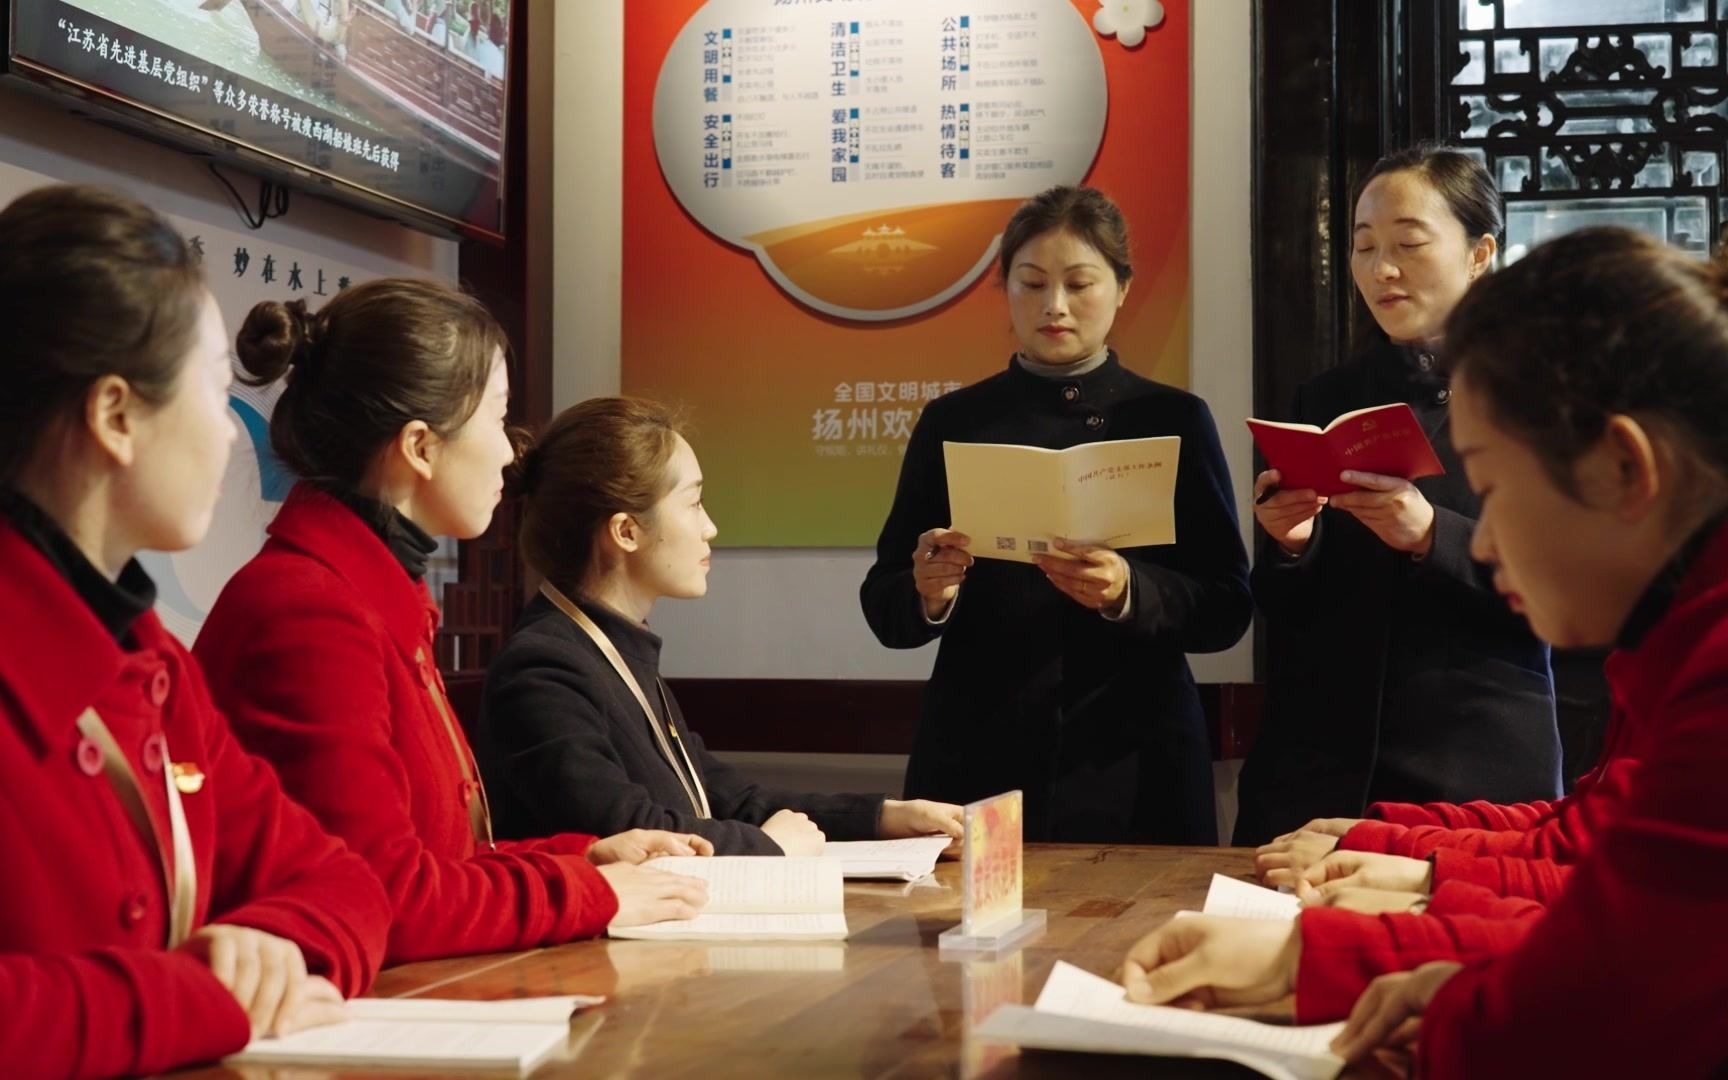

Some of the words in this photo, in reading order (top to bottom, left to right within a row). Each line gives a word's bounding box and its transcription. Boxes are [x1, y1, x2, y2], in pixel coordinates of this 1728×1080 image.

[704, 30, 719, 103] 文明用餐
[831, 21, 847, 97] 清洁卫生
[941, 16, 957, 91] 公共场所
[704, 113, 719, 188] 安全出行
[832, 108, 847, 183] 爱我家园
[941, 104, 957, 179] 热情待客
[812, 407, 924, 441] 扬州欢
